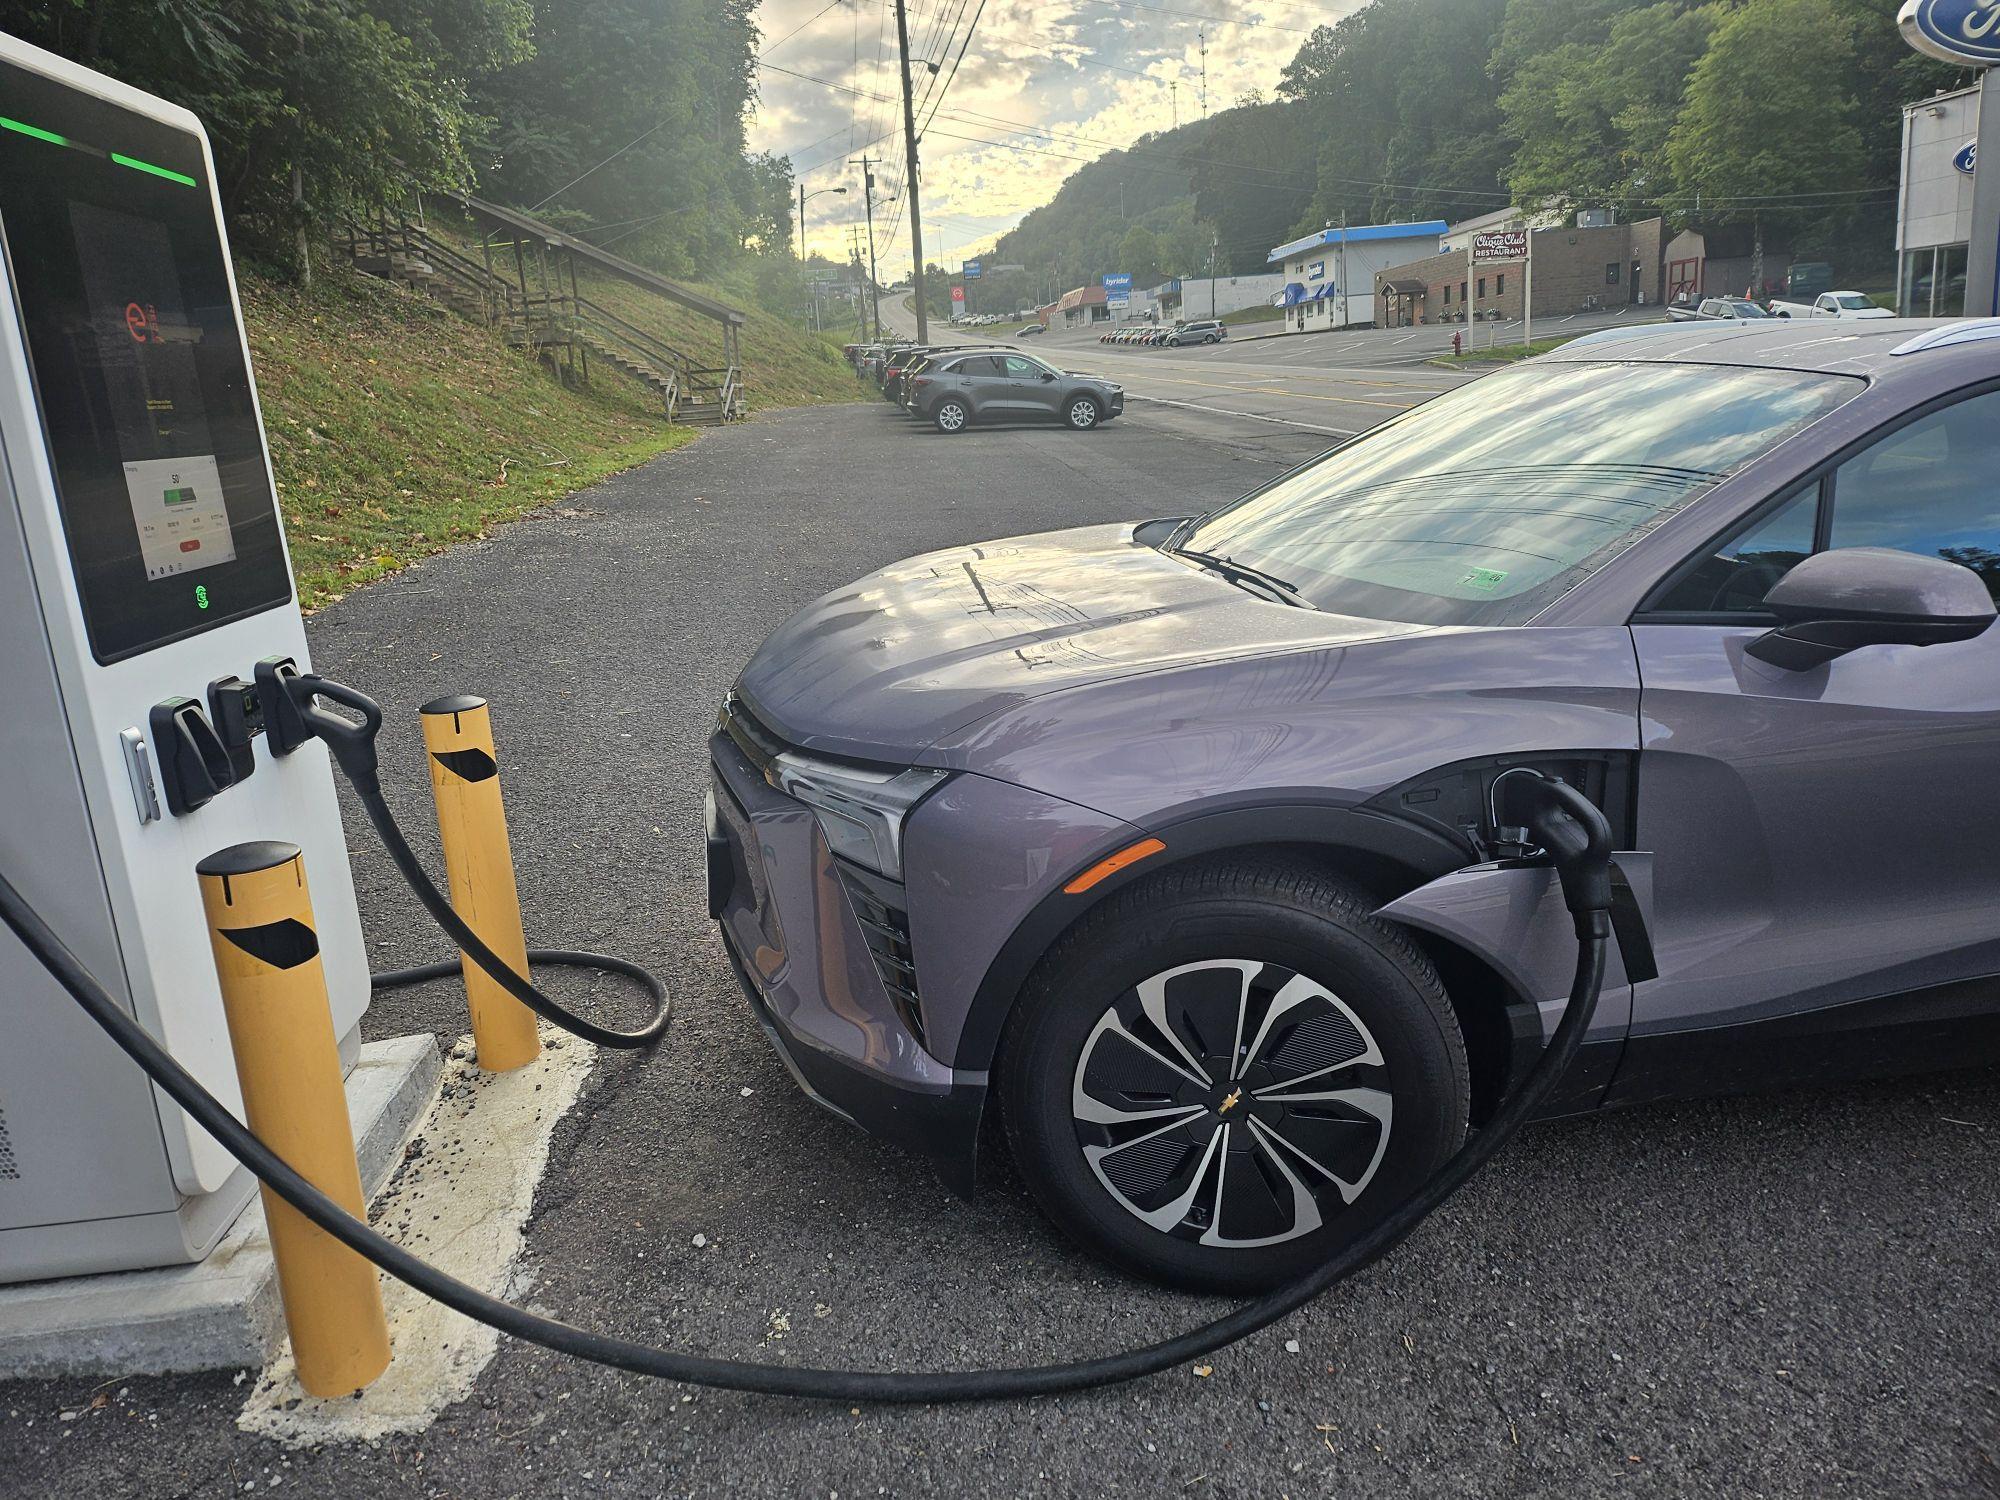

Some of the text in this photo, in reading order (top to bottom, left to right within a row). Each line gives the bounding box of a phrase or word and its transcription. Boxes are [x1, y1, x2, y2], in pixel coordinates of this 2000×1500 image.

[1476, 231, 1525, 248] Clique Club
[1475, 247, 1526, 257] RESTAURANT
[1105, 276, 1129, 286] byrider
